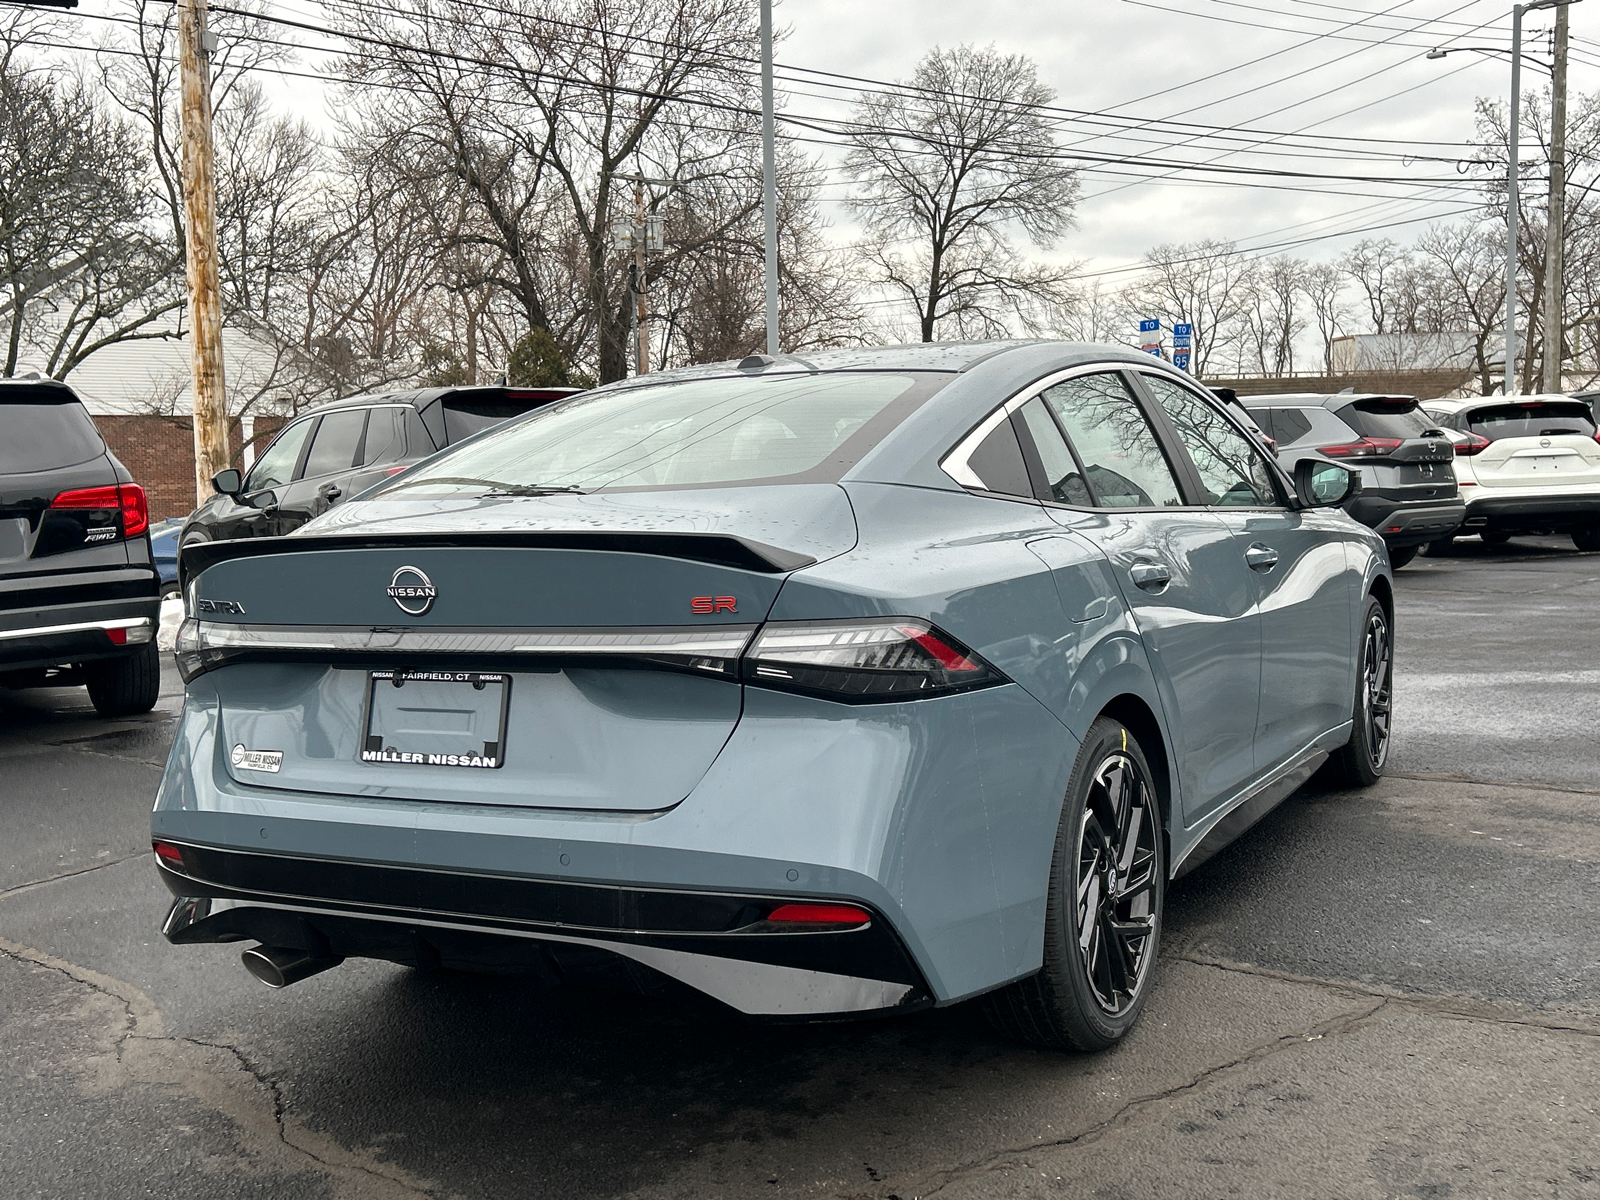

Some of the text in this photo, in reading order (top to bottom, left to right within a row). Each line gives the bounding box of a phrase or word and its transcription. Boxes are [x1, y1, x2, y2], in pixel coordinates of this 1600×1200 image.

[1145, 322, 1155, 330] TO
[1178, 326, 1187, 334] TO
[1174, 338, 1190, 346] SOUTH
[1175, 356, 1187, 368] 95
[387, 588, 436, 597] NISSAN
[691, 595, 739, 614] SR
[402, 672, 470, 681] FAIRFIELD, CT
[244, 753, 281, 766] MILLER NISSAN
[362, 751, 496, 768] MILLER NISSAN
